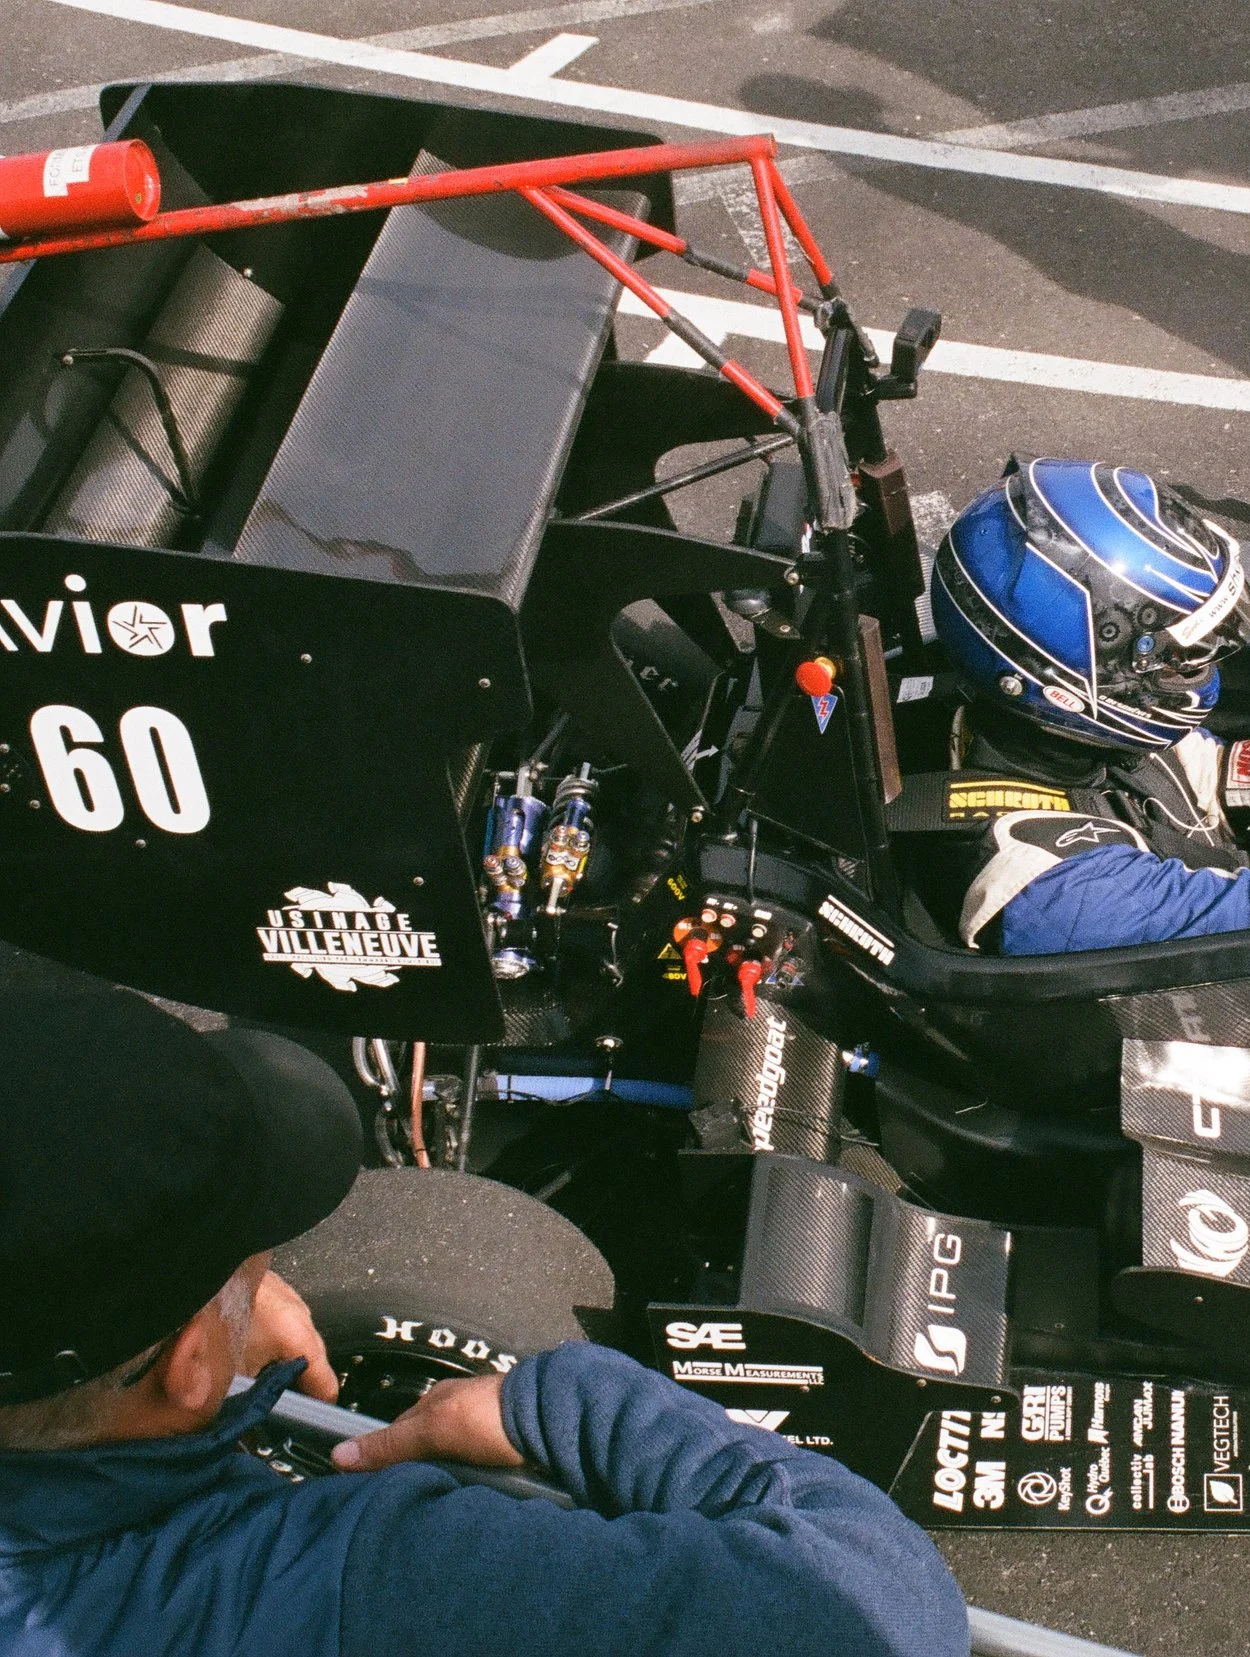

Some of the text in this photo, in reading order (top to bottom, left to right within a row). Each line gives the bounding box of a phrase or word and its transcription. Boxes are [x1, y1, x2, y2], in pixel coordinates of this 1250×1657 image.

[1049, 690, 1077, 710] BELL
[30, 704, 211, 834] 60
[949, 790, 1070, 811] SCHROTH
[257, 929, 440, 958] VILLENEUVE
[267, 909, 413, 932] USINAGE
[754, 1015, 787, 1151] peedgoat
[927, 1233, 962, 1315] IPG
[374, 1316, 518, 1374] Hoos
[665, 1322, 747, 1350] SAE
[1049, 1384, 1067, 1442] PUMPS
[1212, 1395, 1231, 1473] VEGTECH
[806, 1435, 834, 1446] LTD.
[933, 1411, 972, 1512] LOCTIT
[973, 1461, 1006, 1510] 3M
[1057, 1466, 1074, 1512] KeyShot
[1086, 1462, 1100, 1494] Hydro
[1130, 1453, 1143, 1510] collectiv
[1171, 1447, 1186, 1497] BOSCH
